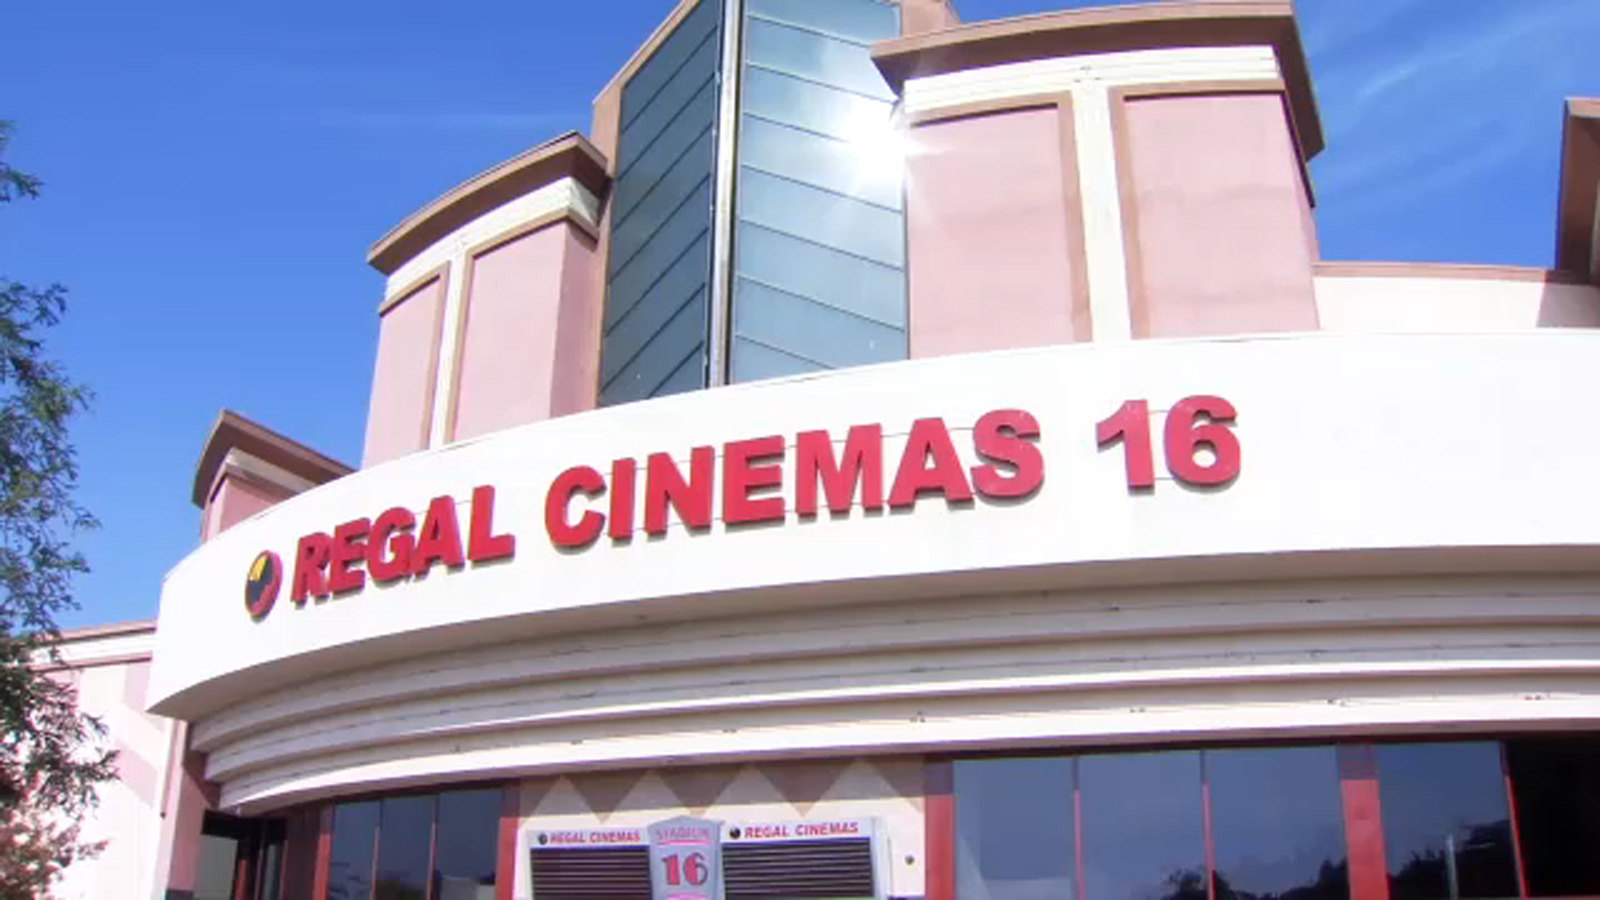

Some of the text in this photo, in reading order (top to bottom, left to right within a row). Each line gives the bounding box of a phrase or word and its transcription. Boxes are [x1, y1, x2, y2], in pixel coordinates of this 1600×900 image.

[292, 395, 1242, 603] REGAL CINEMAS 16
[550, 829, 641, 843] REGAL CINEMAS
[744, 821, 859, 838] REGAL CINEMAS
[662, 852, 709, 886] 16
